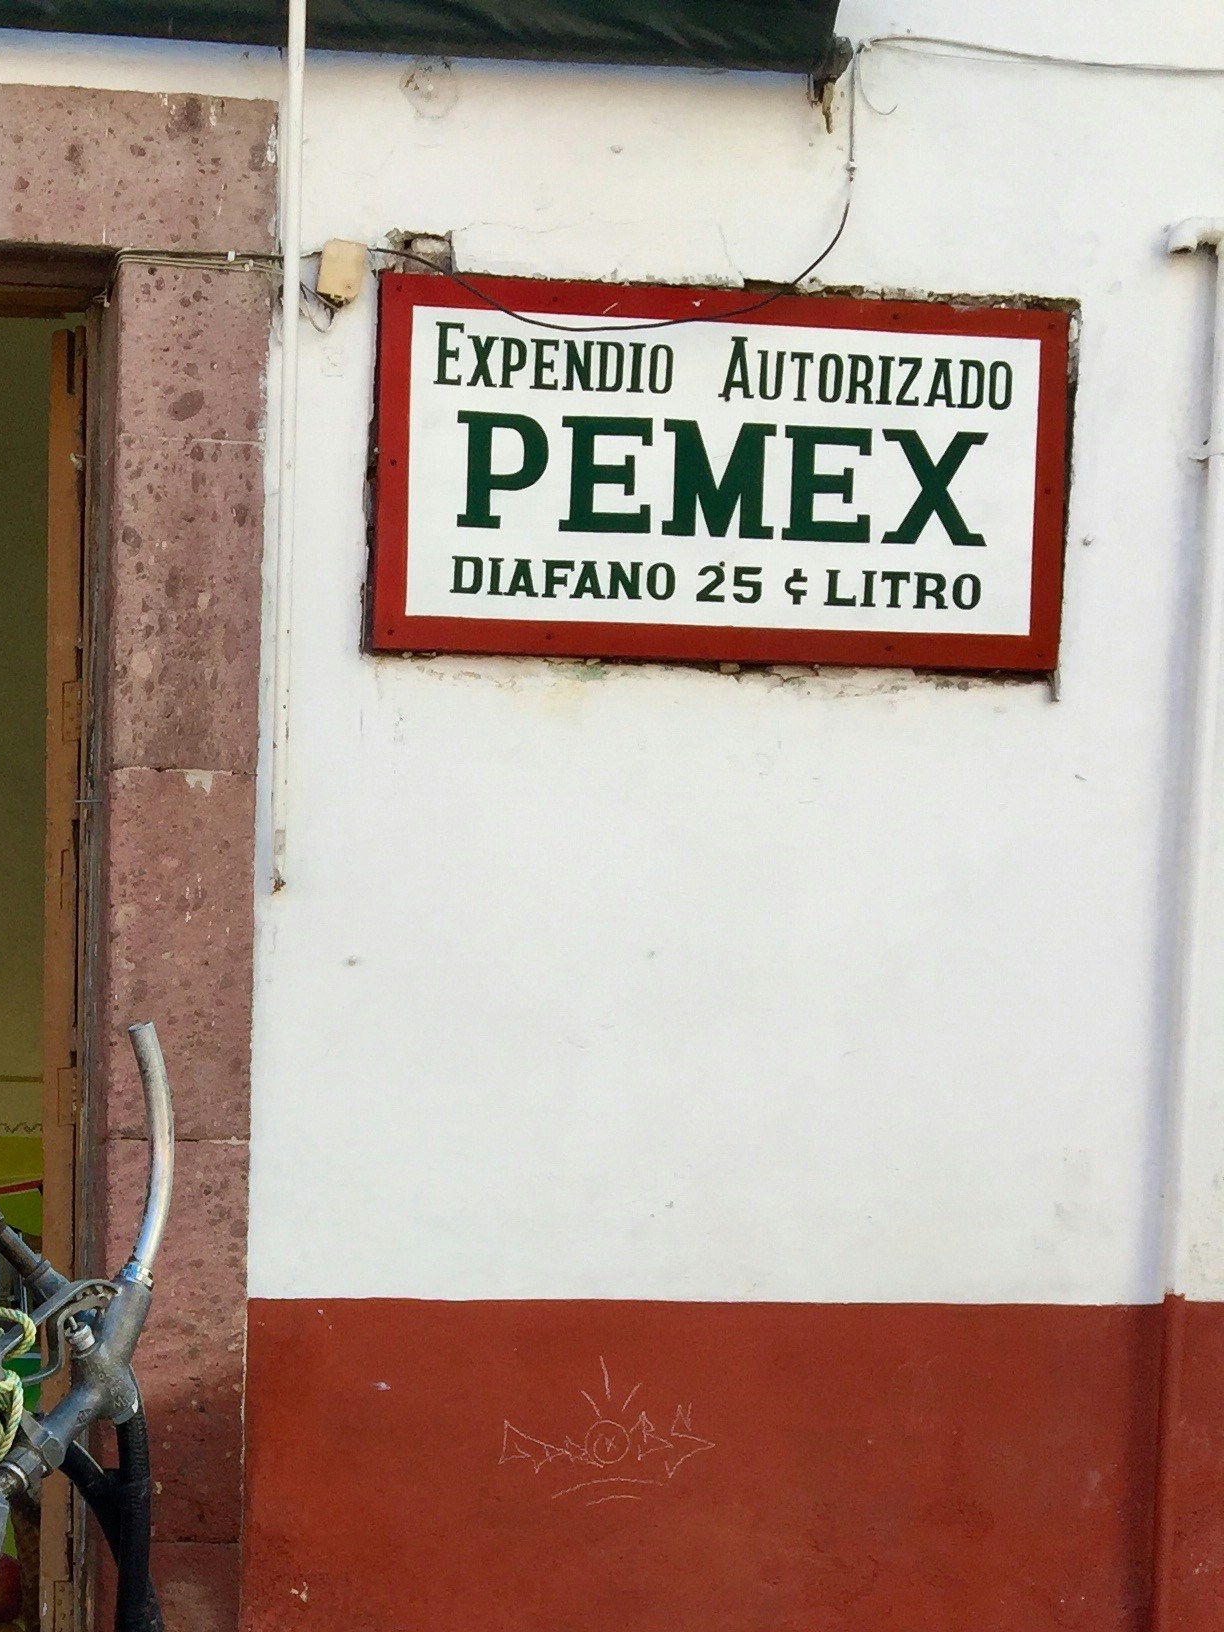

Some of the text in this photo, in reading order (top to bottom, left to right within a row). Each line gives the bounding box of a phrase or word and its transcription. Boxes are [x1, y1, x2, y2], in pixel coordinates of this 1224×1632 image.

[434, 322, 1013, 410] EXPENDIO AUTORIZADO
[456, 410, 989, 547] PEMEX
[450, 555, 676, 600] DIAFANO
[696, 565, 763, 605] 25
[824, 570, 981, 611] LITRO
